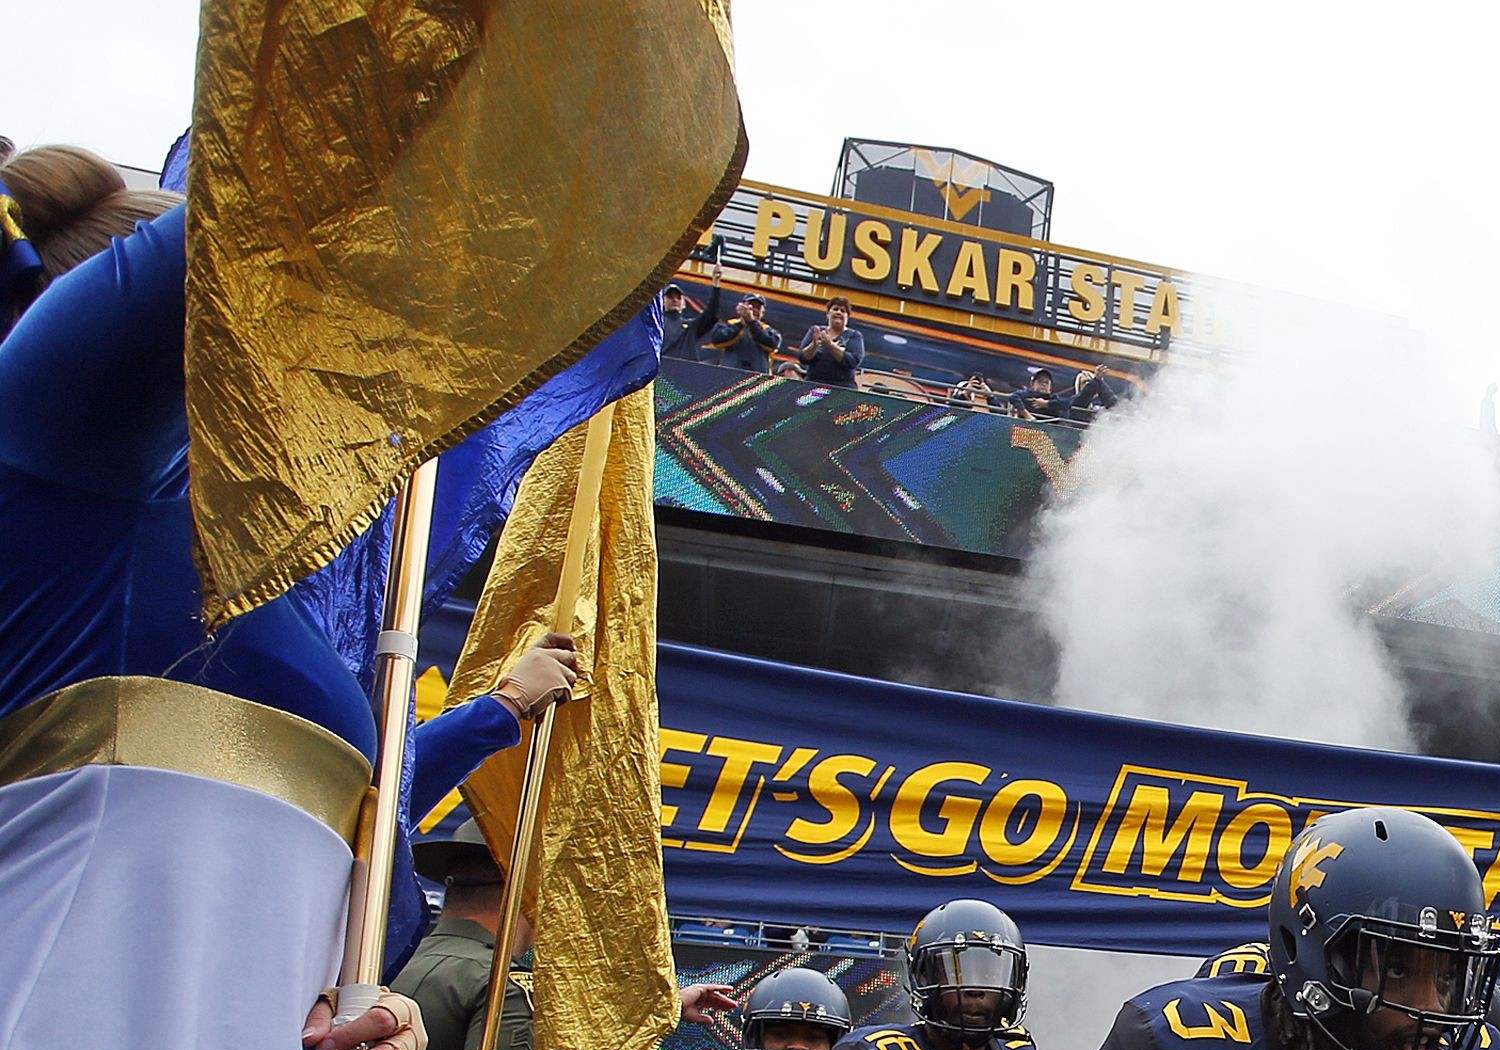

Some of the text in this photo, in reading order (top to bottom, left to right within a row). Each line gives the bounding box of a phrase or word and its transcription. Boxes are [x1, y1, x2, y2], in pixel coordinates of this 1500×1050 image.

[752, 199, 1184, 337] PUSKAR STA
[659, 727, 876, 845] ET'S
[889, 761, 1067, 867] GO
[1162, 997, 1252, 1044] 3
